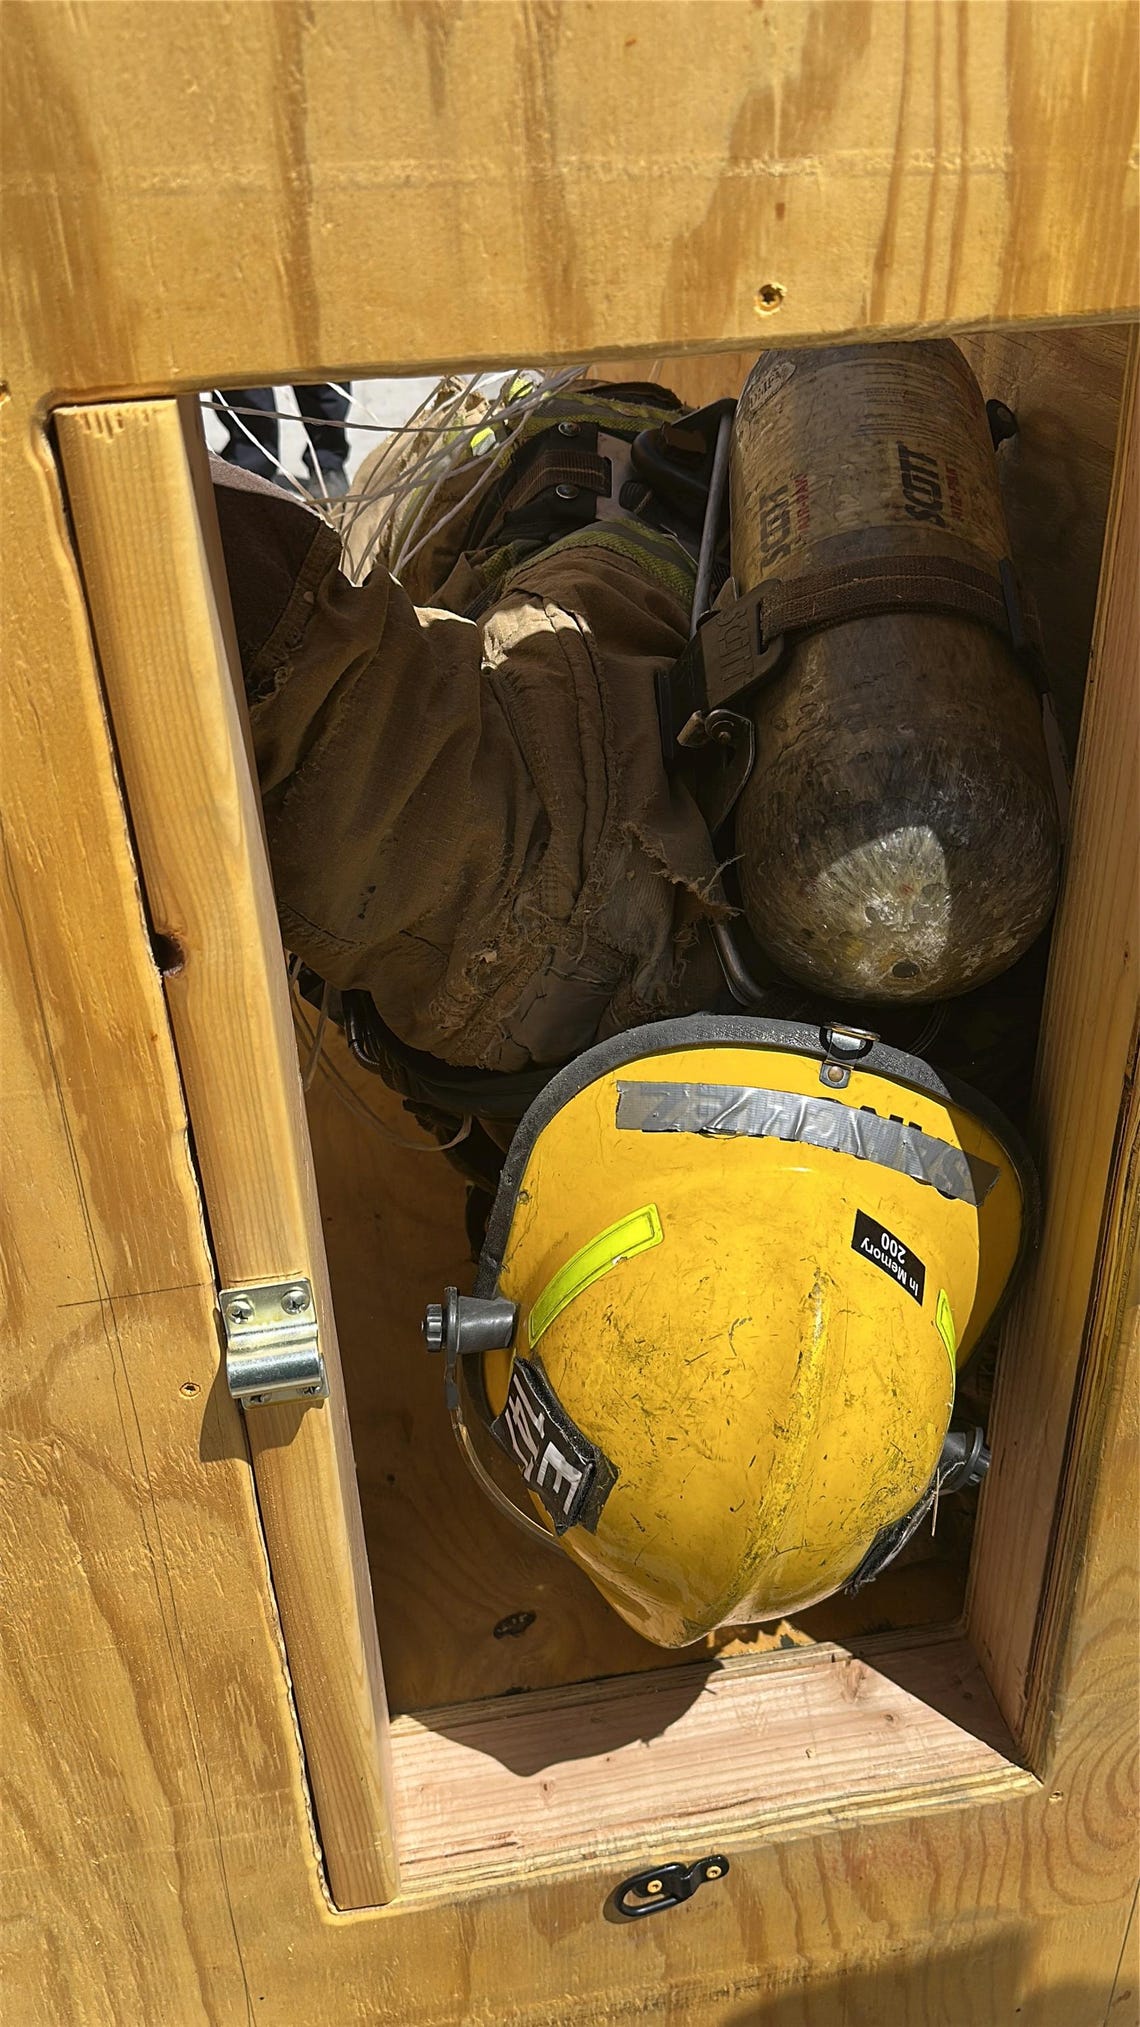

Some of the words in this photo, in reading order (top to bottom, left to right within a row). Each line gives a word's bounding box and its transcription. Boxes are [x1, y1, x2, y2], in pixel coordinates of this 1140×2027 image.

[897, 441, 947, 528] SCOTT
[760, 484, 791, 568] SCOTT
[860, 1237, 907, 1285] Memory
[880, 1232, 907, 1265] 200
[909, 1277, 919, 1297] In
[536, 1440, 583, 1516] E
